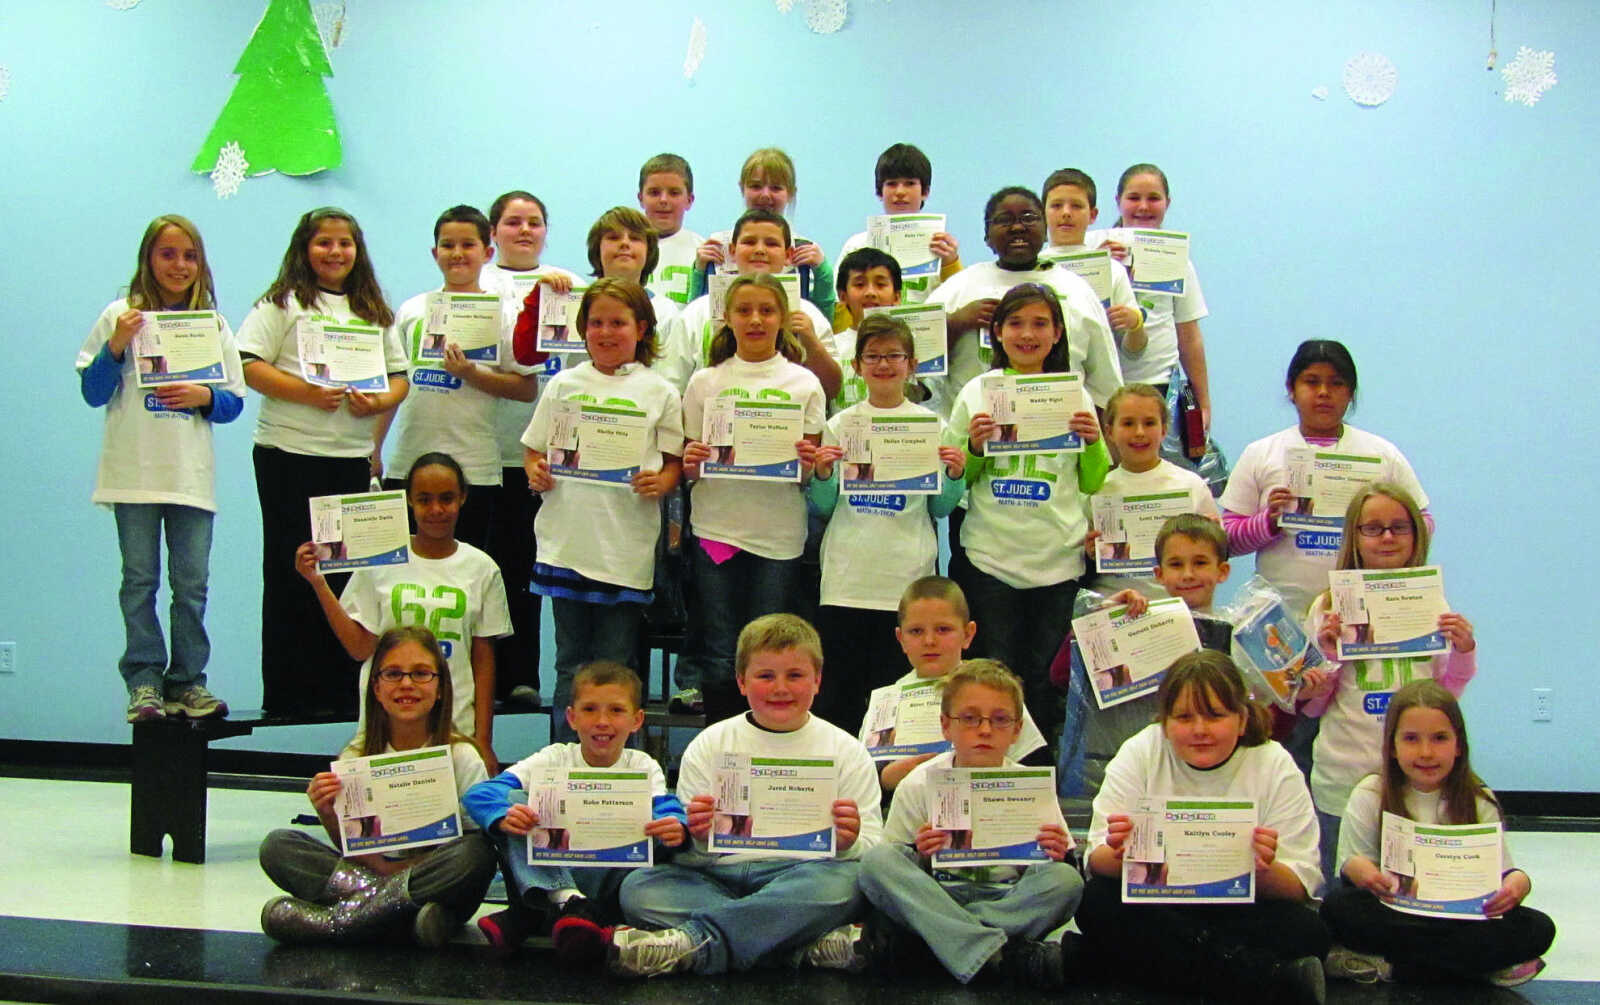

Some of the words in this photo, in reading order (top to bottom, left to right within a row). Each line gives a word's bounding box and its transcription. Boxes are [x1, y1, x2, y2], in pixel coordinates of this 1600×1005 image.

[426, 373, 446, 384] JUDE
[1006, 484, 1033, 496] JUDE
[1298, 535, 1313, 545] ST.
[1314, 535, 1342, 546] JUDE
